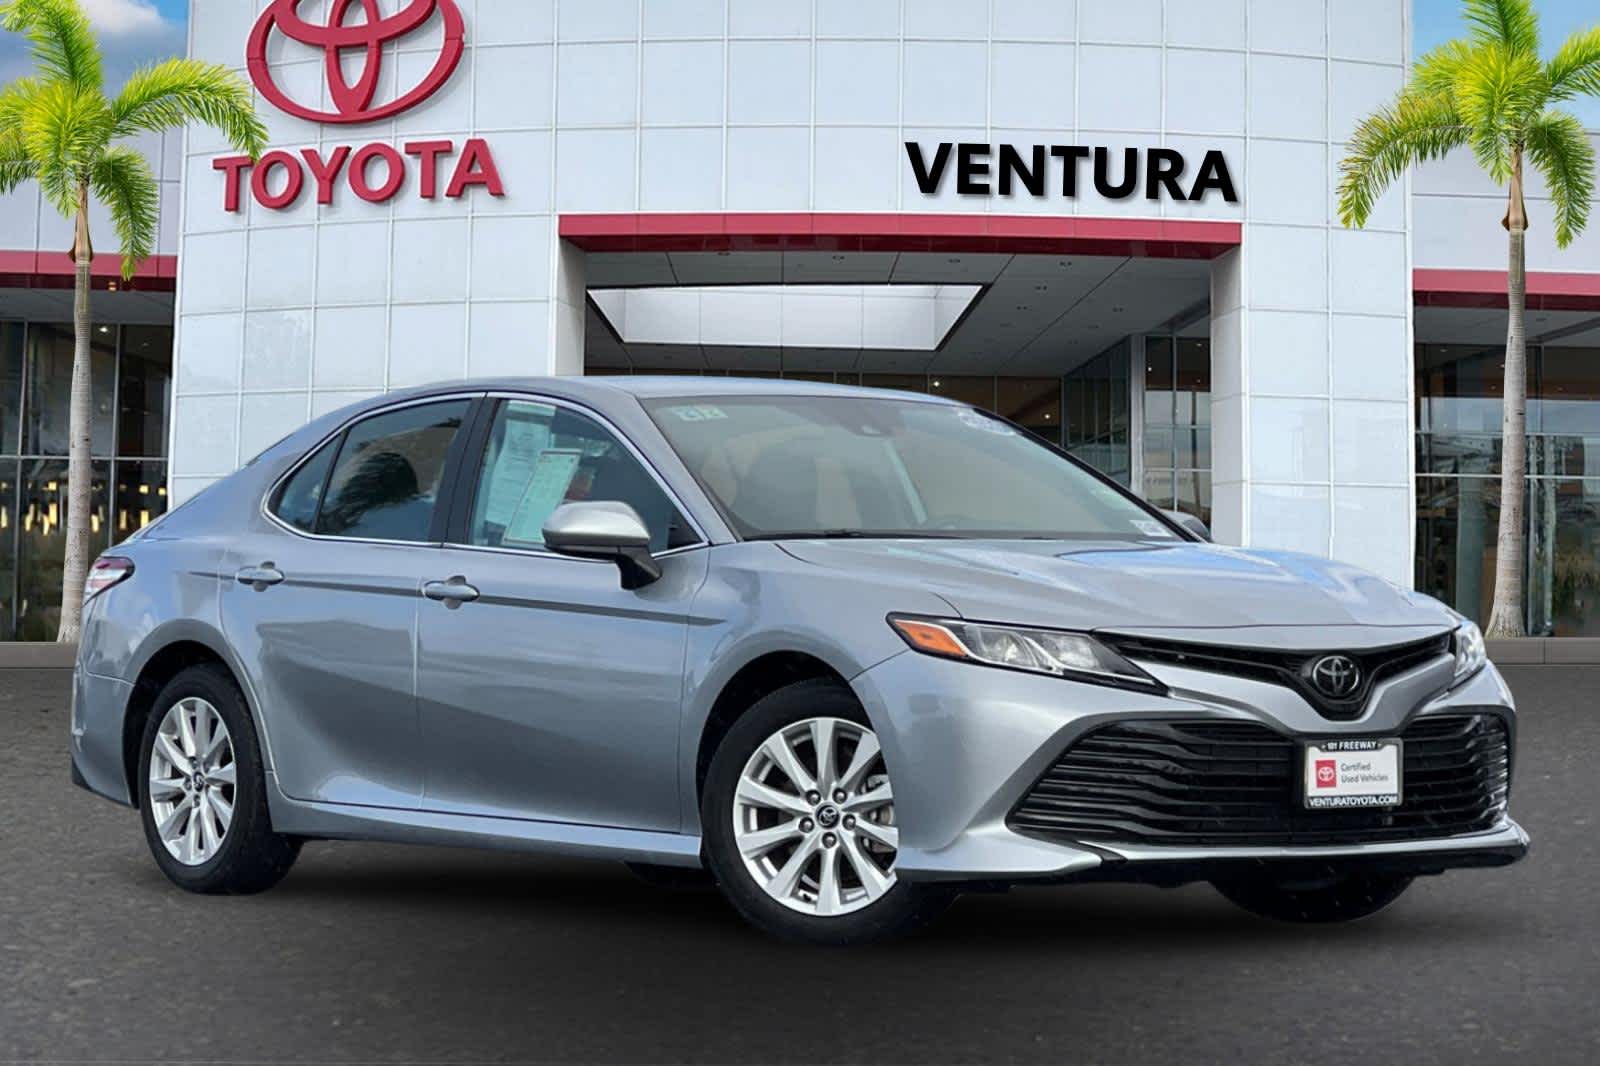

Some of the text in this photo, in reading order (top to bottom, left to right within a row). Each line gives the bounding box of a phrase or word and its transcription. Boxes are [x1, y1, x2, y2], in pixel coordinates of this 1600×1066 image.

[212, 138, 505, 212] TOYOTA
[904, 141, 1239, 203] VENTURA
[1339, 741, 1377, 750] FREEWAY
[1340, 762, 1371, 771] Certified
[1341, 774, 1389, 783] Used Vehicles
[1309, 795, 1398, 807] VENTURATOYOTA.COM
